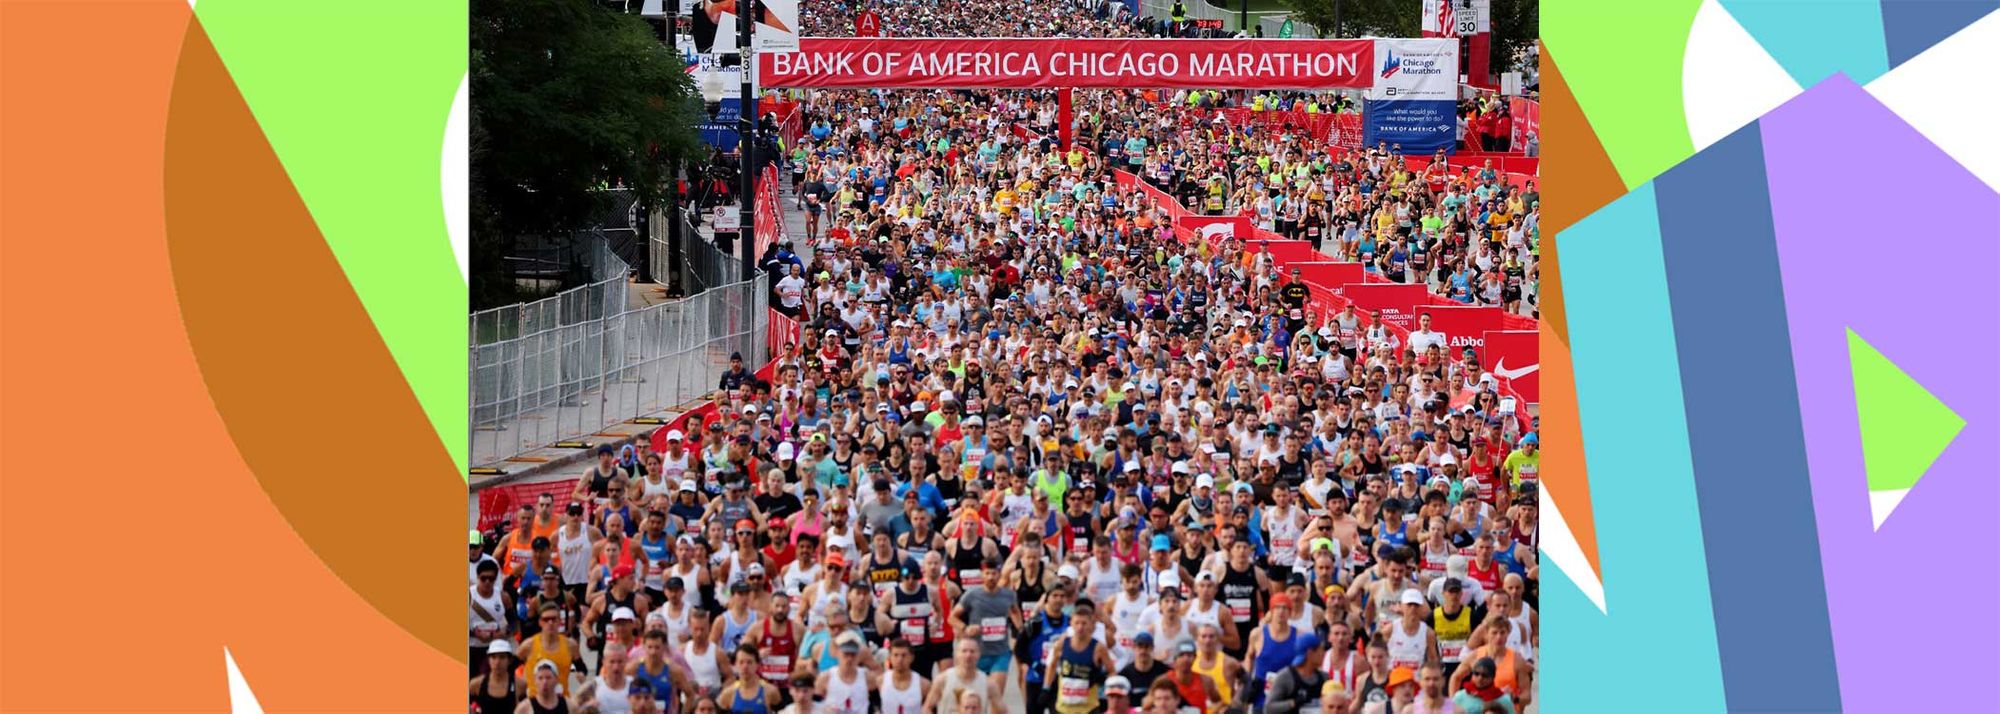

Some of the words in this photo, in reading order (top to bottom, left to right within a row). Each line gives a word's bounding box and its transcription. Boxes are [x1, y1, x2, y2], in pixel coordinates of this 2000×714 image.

[861, 13, 875, 30] A
[1459, 21, 1476, 32] 30
[773, 52, 855, 76] BANK
[862, 52, 901, 76] OF
[908, 52, 1041, 76] AMERICA
[1049, 52, 1179, 77] CHICAGO
[1189, 53, 1357, 77] MARATHON
[1402, 59, 1435, 68] Chicago
[1402, 67, 1441, 75] Marathon
[1450, 336, 1484, 347] Abbo
